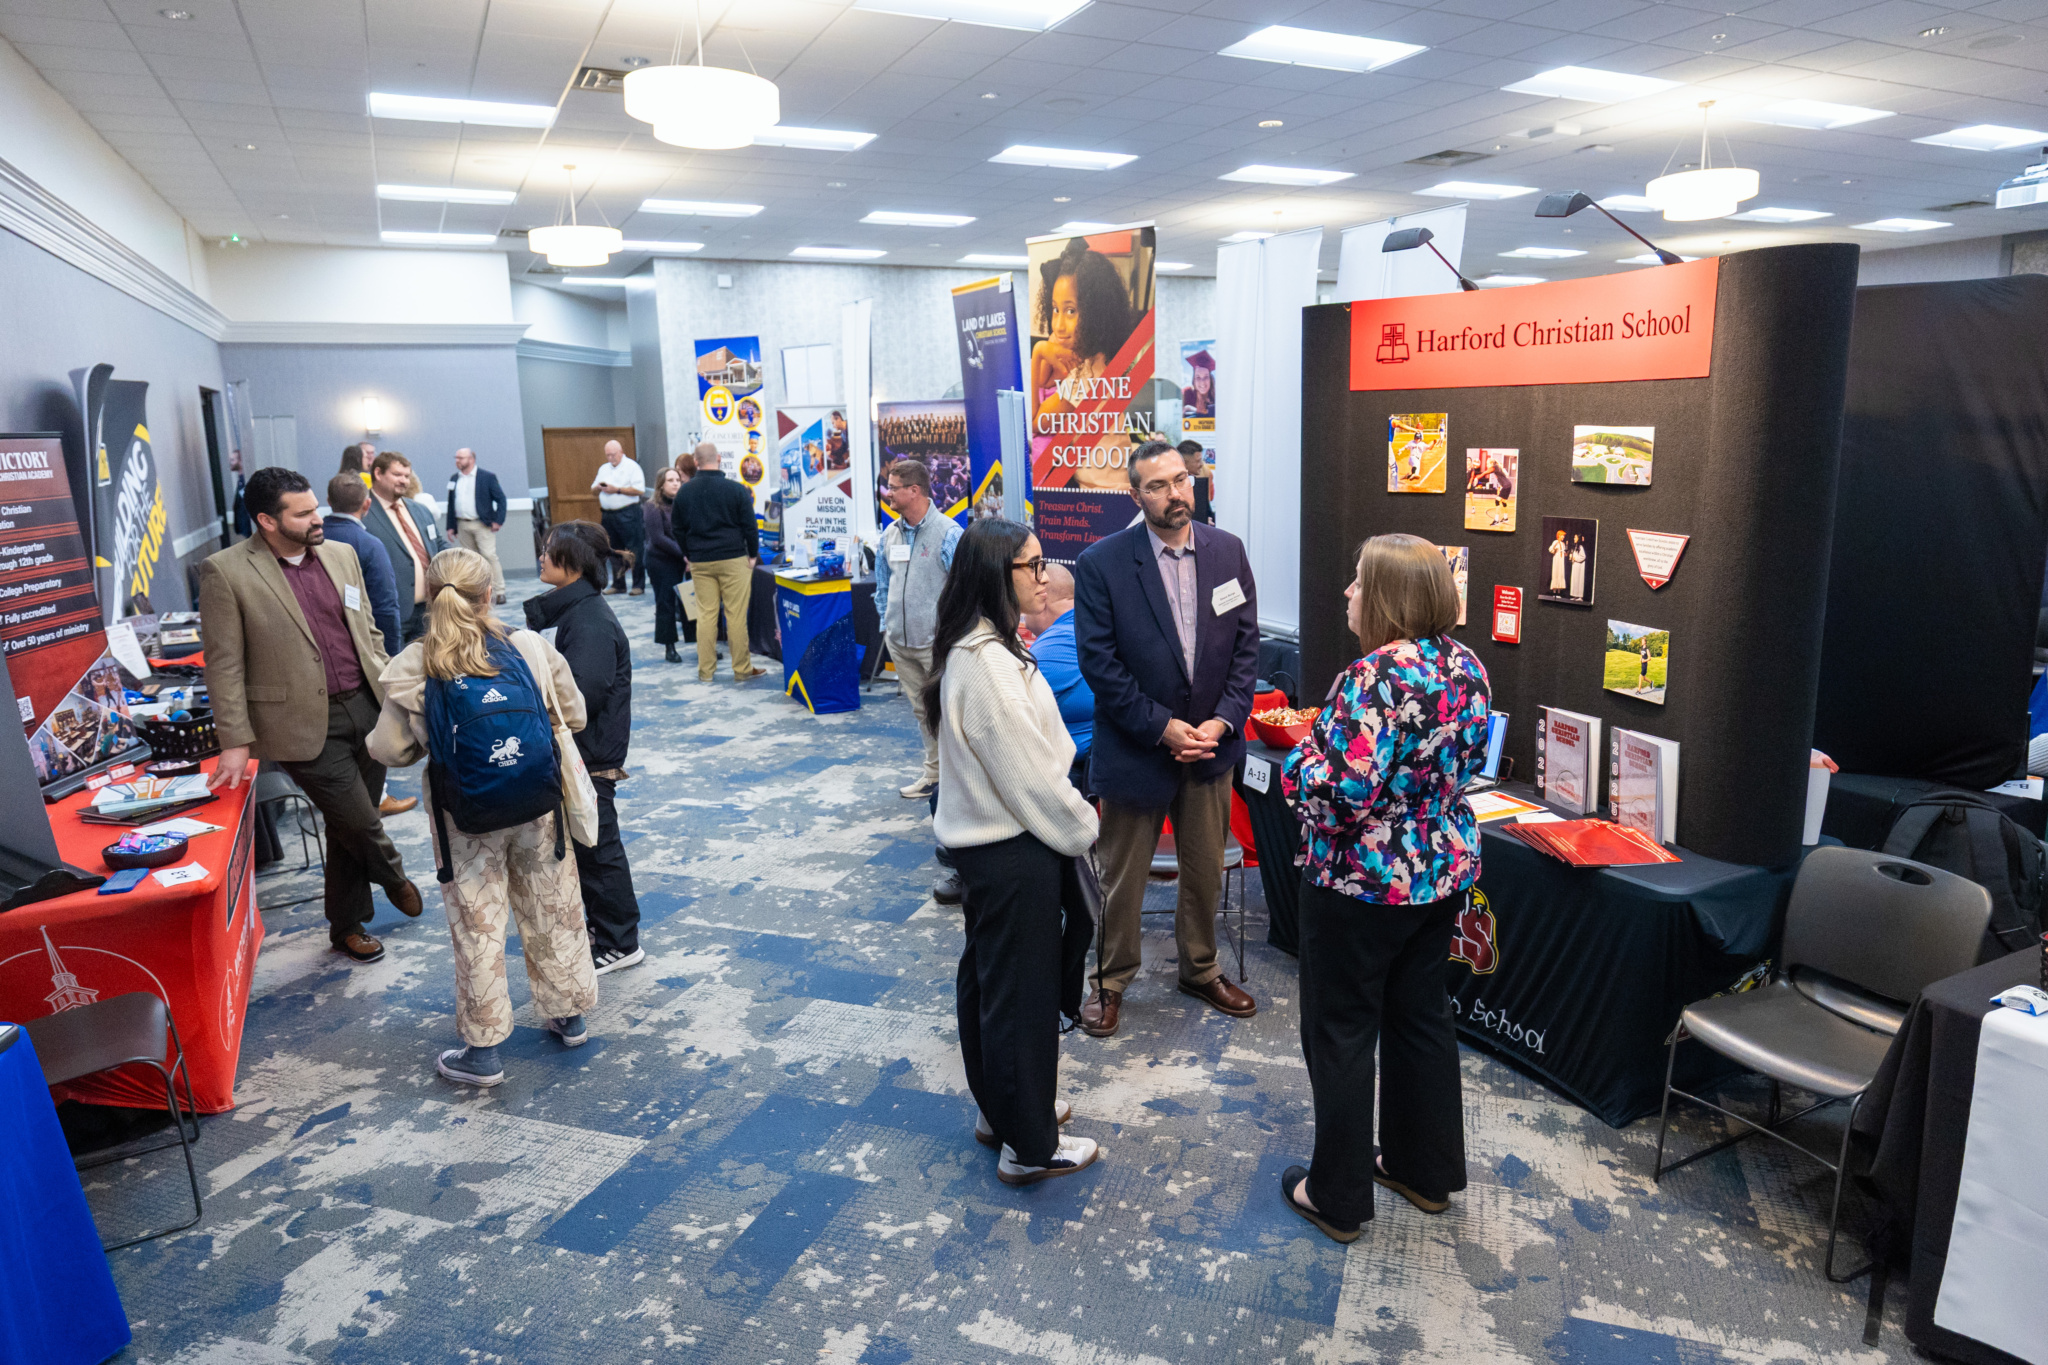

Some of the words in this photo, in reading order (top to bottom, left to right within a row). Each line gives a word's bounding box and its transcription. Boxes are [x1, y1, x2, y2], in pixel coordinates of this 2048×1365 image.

[962, 317, 978, 332] LAND
[986, 311, 1006, 328] LAKES
[1416, 324, 1506, 353] Harford
[1513, 316, 1614, 348] Christian
[1621, 304, 1691, 340] School
[1054, 376, 1132, 400] WAYNE
[1037, 411, 1152, 435] CHRISTIAN
[818, 496, 833, 504] LIVE
[834, 496, 844, 504] ON
[1039, 500, 1074, 512] Treasure
[1076, 502, 1104, 514] Christ.
[0, 505, 32, 516] Christian
[816, 506, 846, 514] MISSION
[806, 517, 824, 525] PLAY
[1039, 514, 1062, 526] Train
[1063, 516, 1091, 528] Minds.
[1040, 529, 1082, 542] Transform
[0, 543, 45, 556] -Kindergarten
[0, 559, 18, 571] rough
[18, 557, 34, 567] 12th
[34, 554, 54, 566] grade
[0, 586, 23, 598] College
[24, 578, 62, 593] Preparatory
[4, 614, 20, 624] Fully
[21, 604, 56, 620] accredited
[11, 640, 27, 650] Over
[27, 636, 36, 646] 50
[36, 632, 56, 645] years
[56, 628, 63, 638] of
[64, 624, 90, 637] ministry
[482, 695, 508, 704] adidas
[498, 758, 518, 768] CHEER
[1248, 767, 1266, 782] A-13
[1469, 998, 1547, 1054] School
